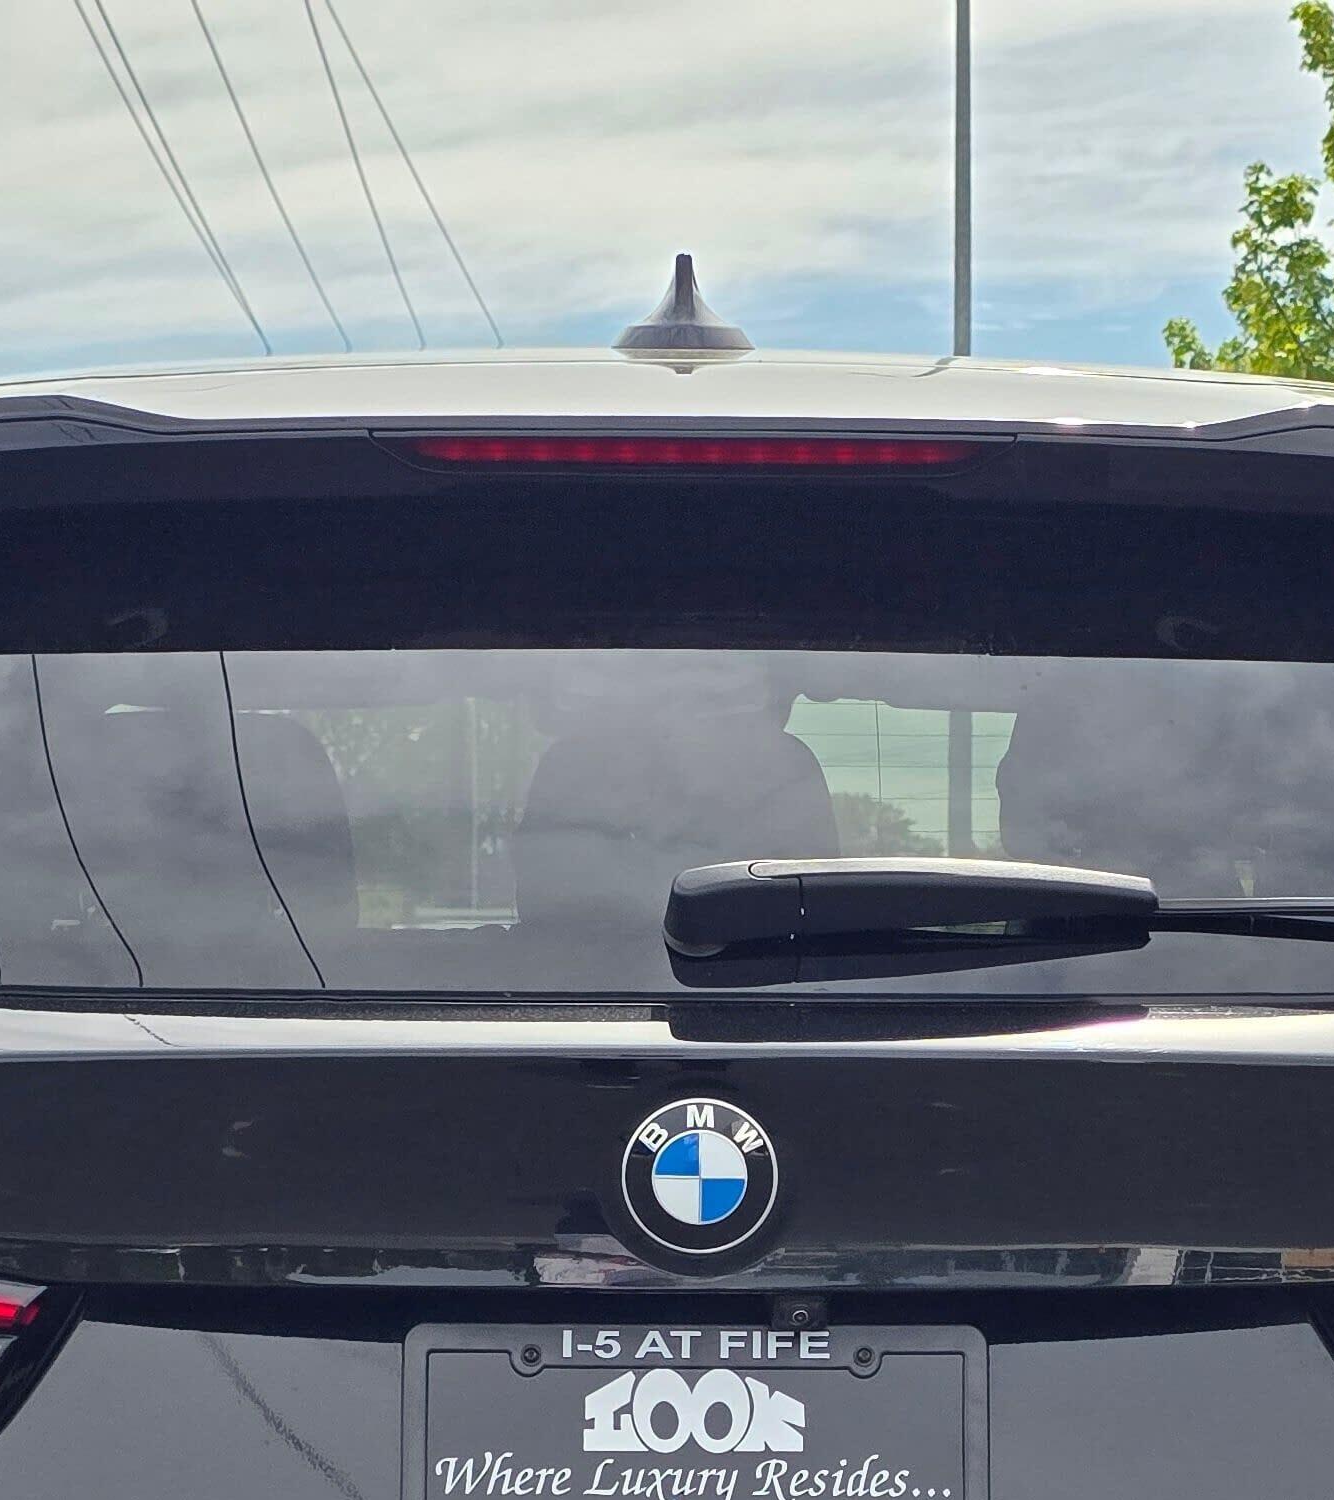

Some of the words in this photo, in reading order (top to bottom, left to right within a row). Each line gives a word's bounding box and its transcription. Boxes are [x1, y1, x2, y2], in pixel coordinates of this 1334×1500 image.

[638, 1104, 764, 1154] BMW
[561, 1328, 622, 1360] I-5
[634, 1329, 702, 1360] AT
[719, 1329, 831, 1360] FIFE
[582, 1367, 807, 1455] LOOK
[434, 1451, 572, 1496] Where
